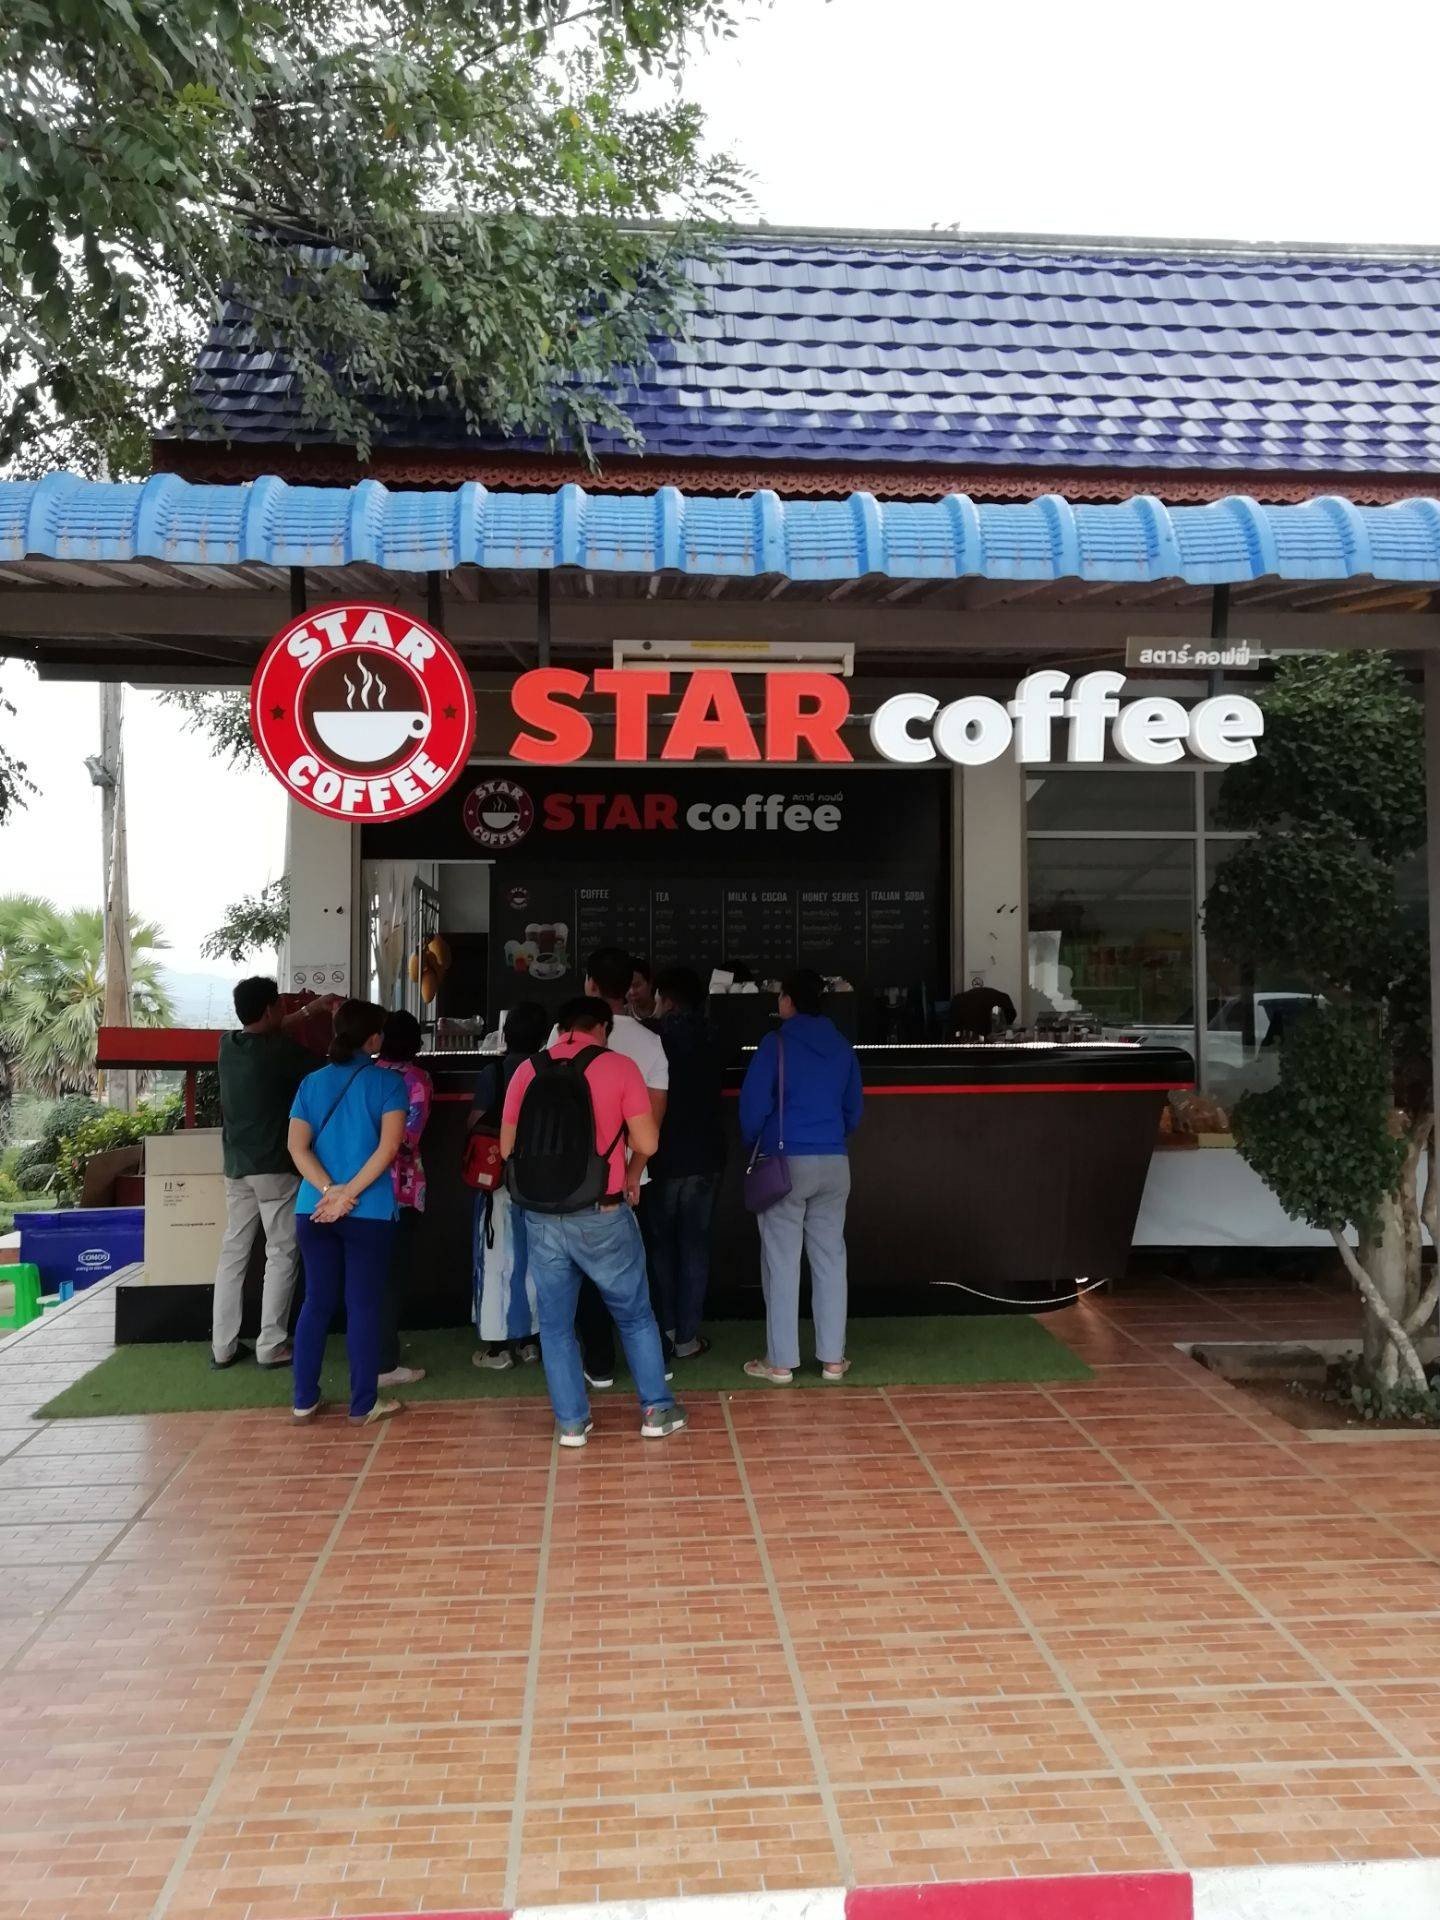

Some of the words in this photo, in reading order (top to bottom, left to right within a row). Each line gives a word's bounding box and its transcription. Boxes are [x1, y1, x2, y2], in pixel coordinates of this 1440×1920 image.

[286, 611, 437, 674] STAR
[1139, 643, 1191, 664] สตาร์
[509, 667, 854, 765] STAR
[870, 669, 1265, 766] coffee
[287, 751, 447, 813] COFFEE
[475, 782, 524, 800] STAR
[543, 793, 679, 832] STAR
[685, 793, 842, 832] coffee
[473, 826, 525, 845] COFFEE
[580, 889, 609, 900] COFFEE
[655, 891, 670, 902] TEA
[727, 891, 748, 902] MILK
[761, 892, 788, 902] COCOA
[802, 892, 828, 902] HONEY
[831, 892, 860, 902] SERIES
[871, 890, 901, 901] ITALIAN
[904, 890, 926, 902] SODA
